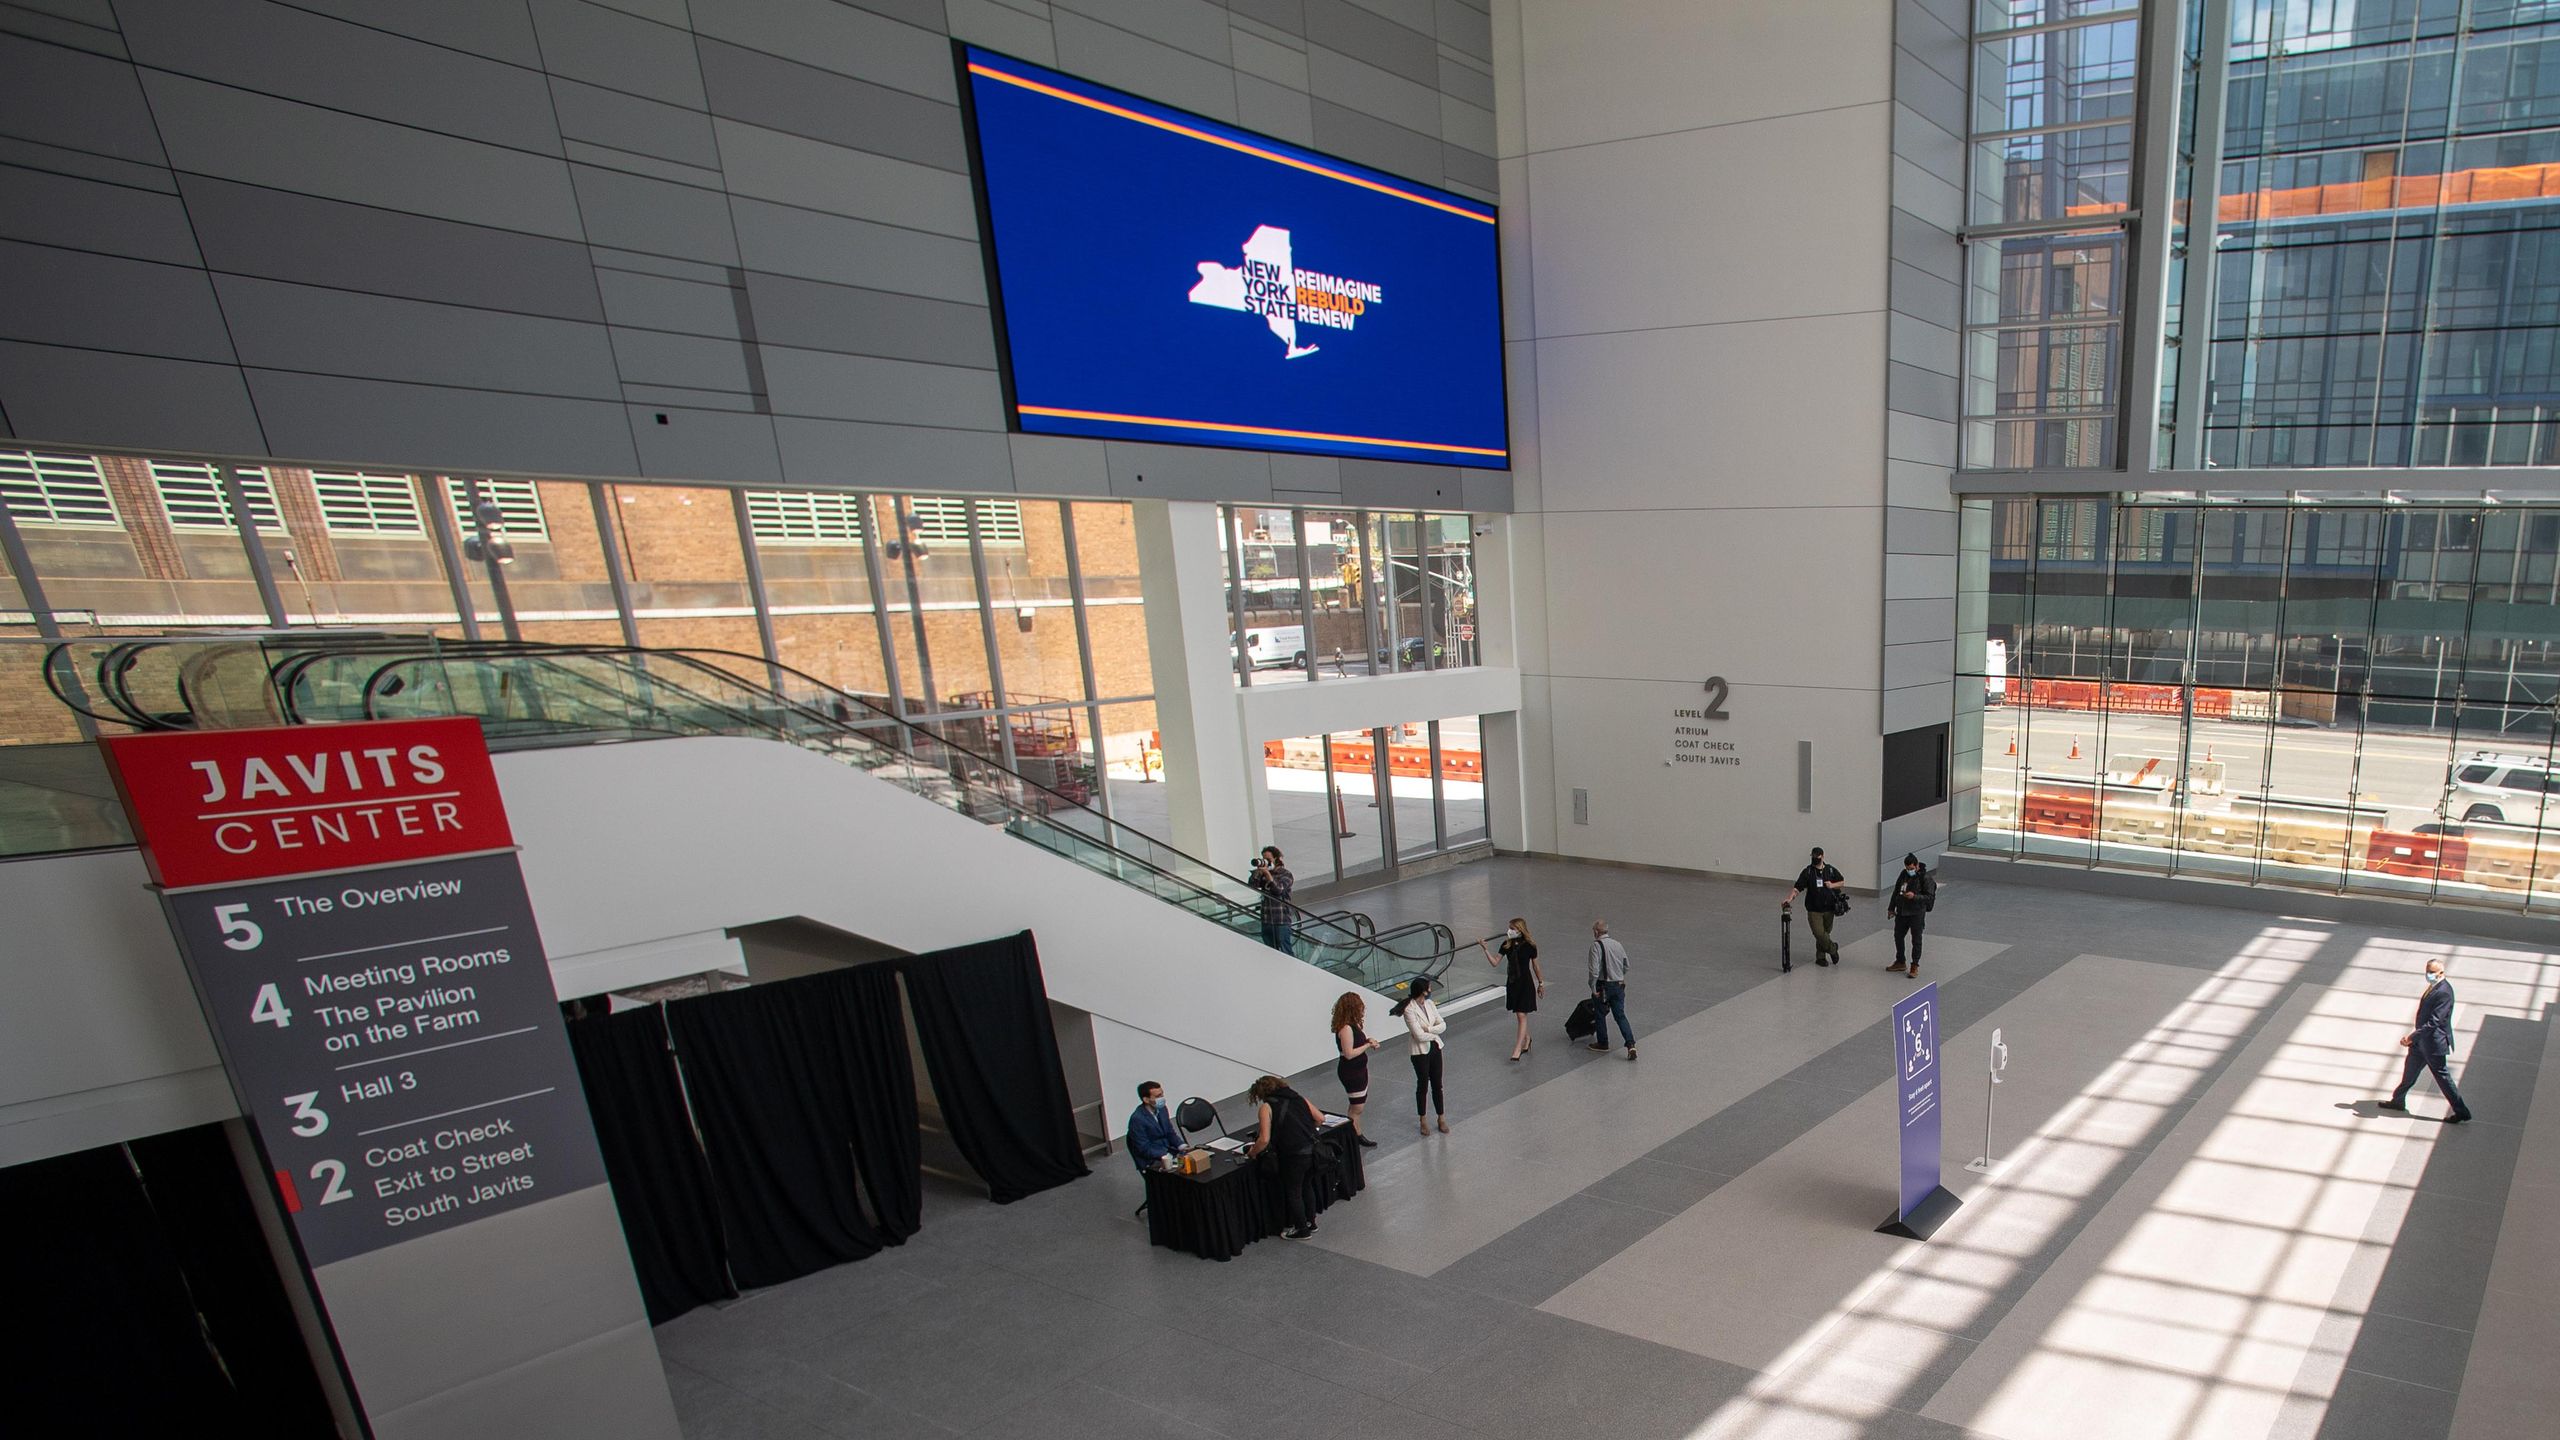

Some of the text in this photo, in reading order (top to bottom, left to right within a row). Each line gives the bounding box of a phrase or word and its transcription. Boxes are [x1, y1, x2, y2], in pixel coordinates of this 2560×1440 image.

[1241, 259, 1280, 282] NEW
[1243, 277, 1290, 302] YORK
[1294, 269, 1382, 303] REIMAGINE
[1244, 296, 1296, 320] STATE
[1296, 287, 1365, 315] REBUILD
[1297, 304, 1355, 331] RENEW
[1674, 676, 1729, 720] LEVEL 2
[1675, 726, 1709, 736] ATRIUM
[1675, 740, 1735, 751] COAT CHECK
[190, 744, 446, 803] JAVITS
[1675, 753, 1741, 766] SOUTH JAVITS
[214, 801, 464, 855] CENTER
[214, 878, 463, 951] 5 The Overview
[303, 945, 511, 997] Meeting Rooms
[250, 982, 477, 1029] 4 The Pavilion
[324, 1008, 481, 1053] on the Farm
[1915, 1033, 1922, 1052] 6
[283, 1071, 418, 1138] 3 Hall 3
[364, 1117, 515, 1168] Coat Check
[309, 1141, 535, 1206] 2 Exit to Street
[384, 1173, 535, 1227] South Javits
